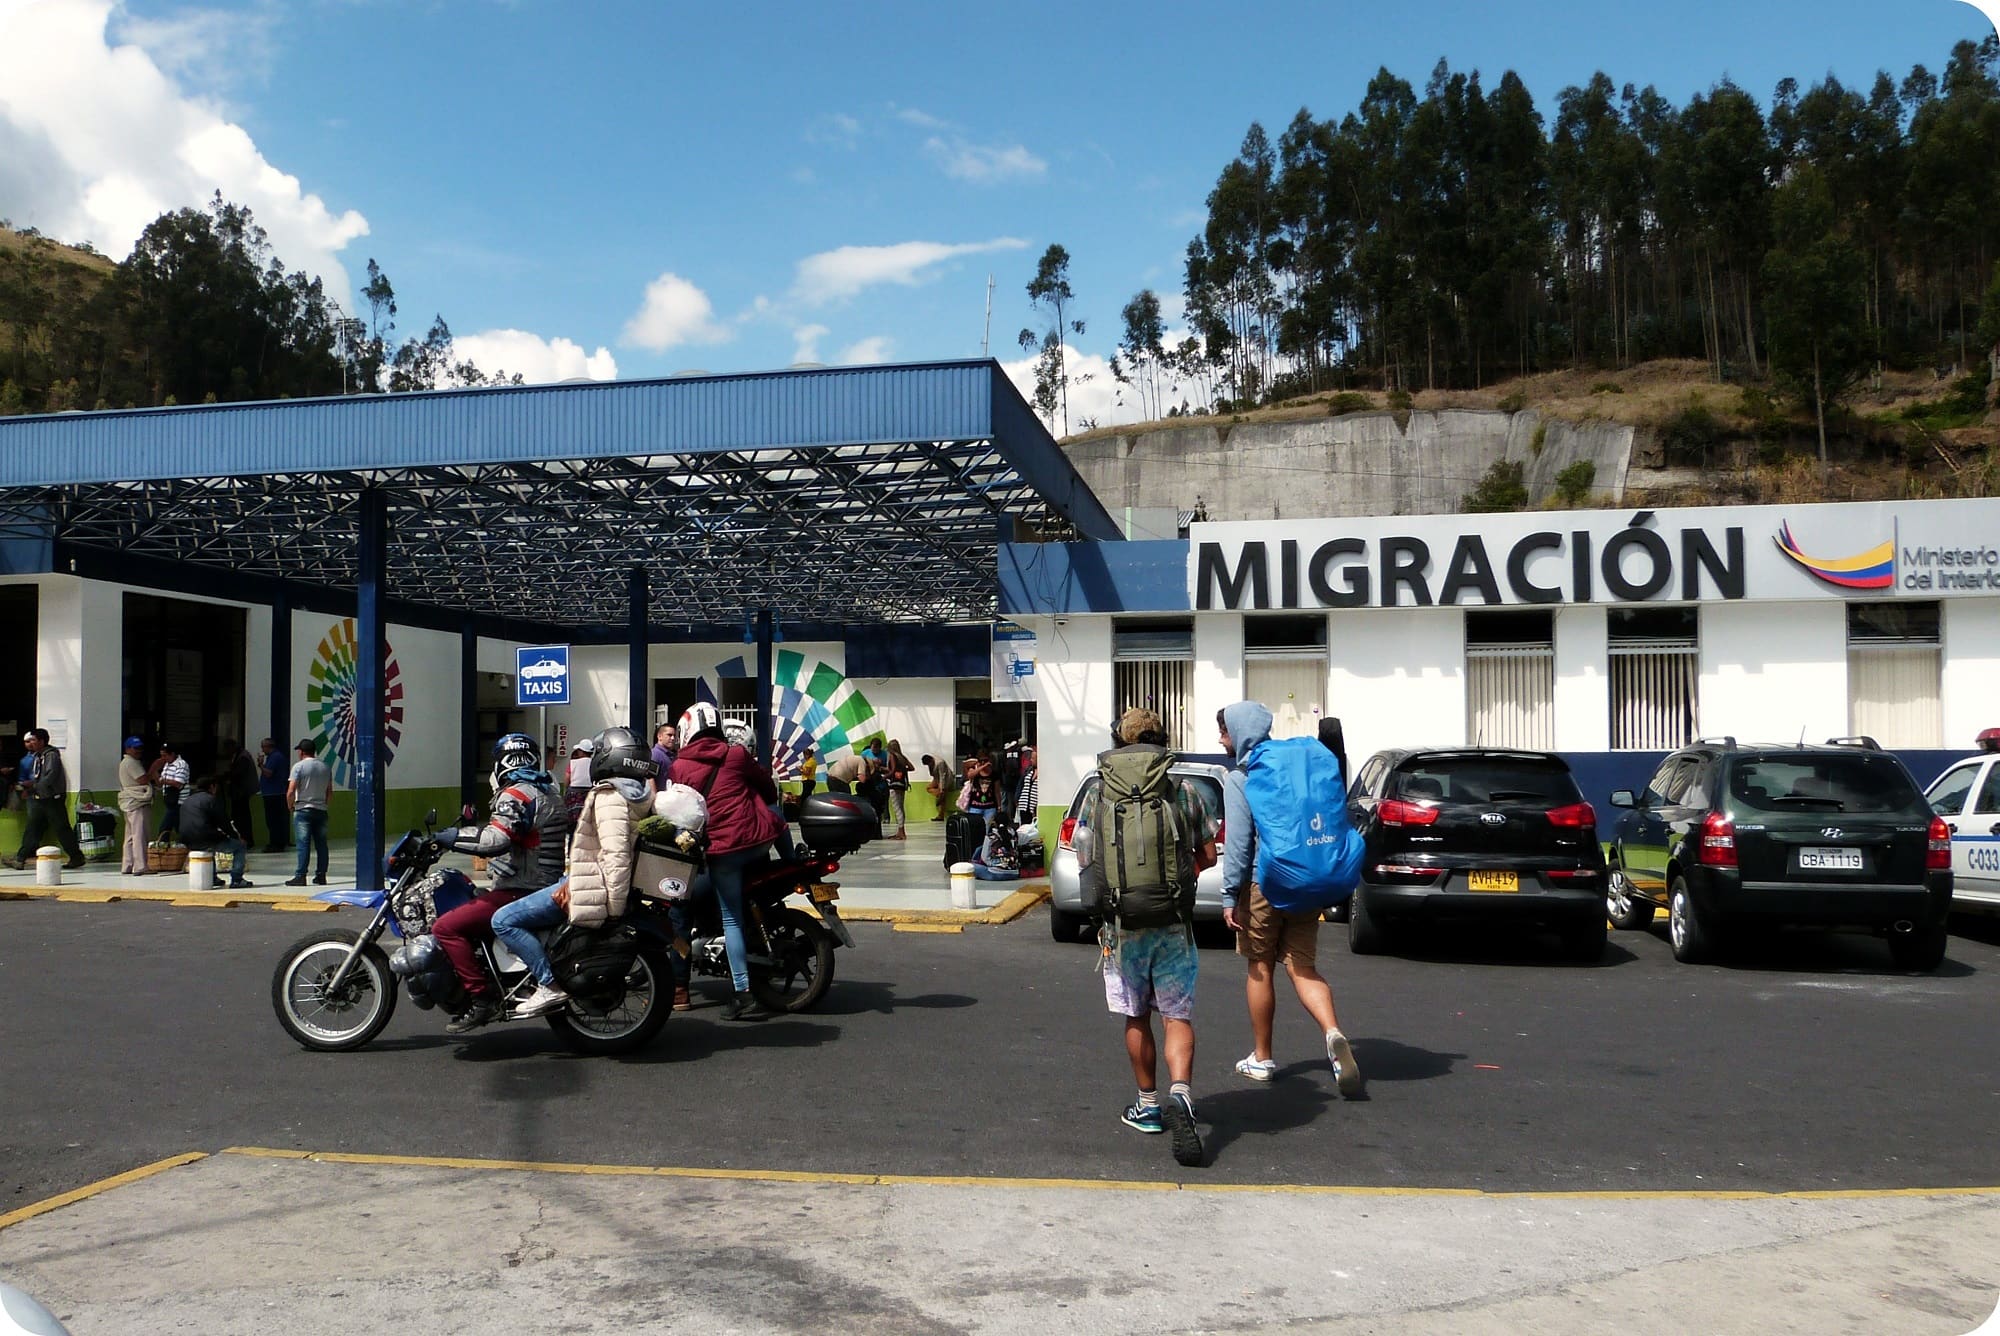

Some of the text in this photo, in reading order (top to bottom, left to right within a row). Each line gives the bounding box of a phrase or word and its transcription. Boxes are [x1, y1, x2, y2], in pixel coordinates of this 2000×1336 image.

[1197, 511, 1745, 609] MIGRACIÓN
[1903, 545, 1998, 566] Ministerio
[1904, 570, 1932, 589] del
[523, 681, 562, 695] TAXIS
[559, 725, 567, 756] COPIAS
[1802, 855, 1860, 867] CBA-1119
